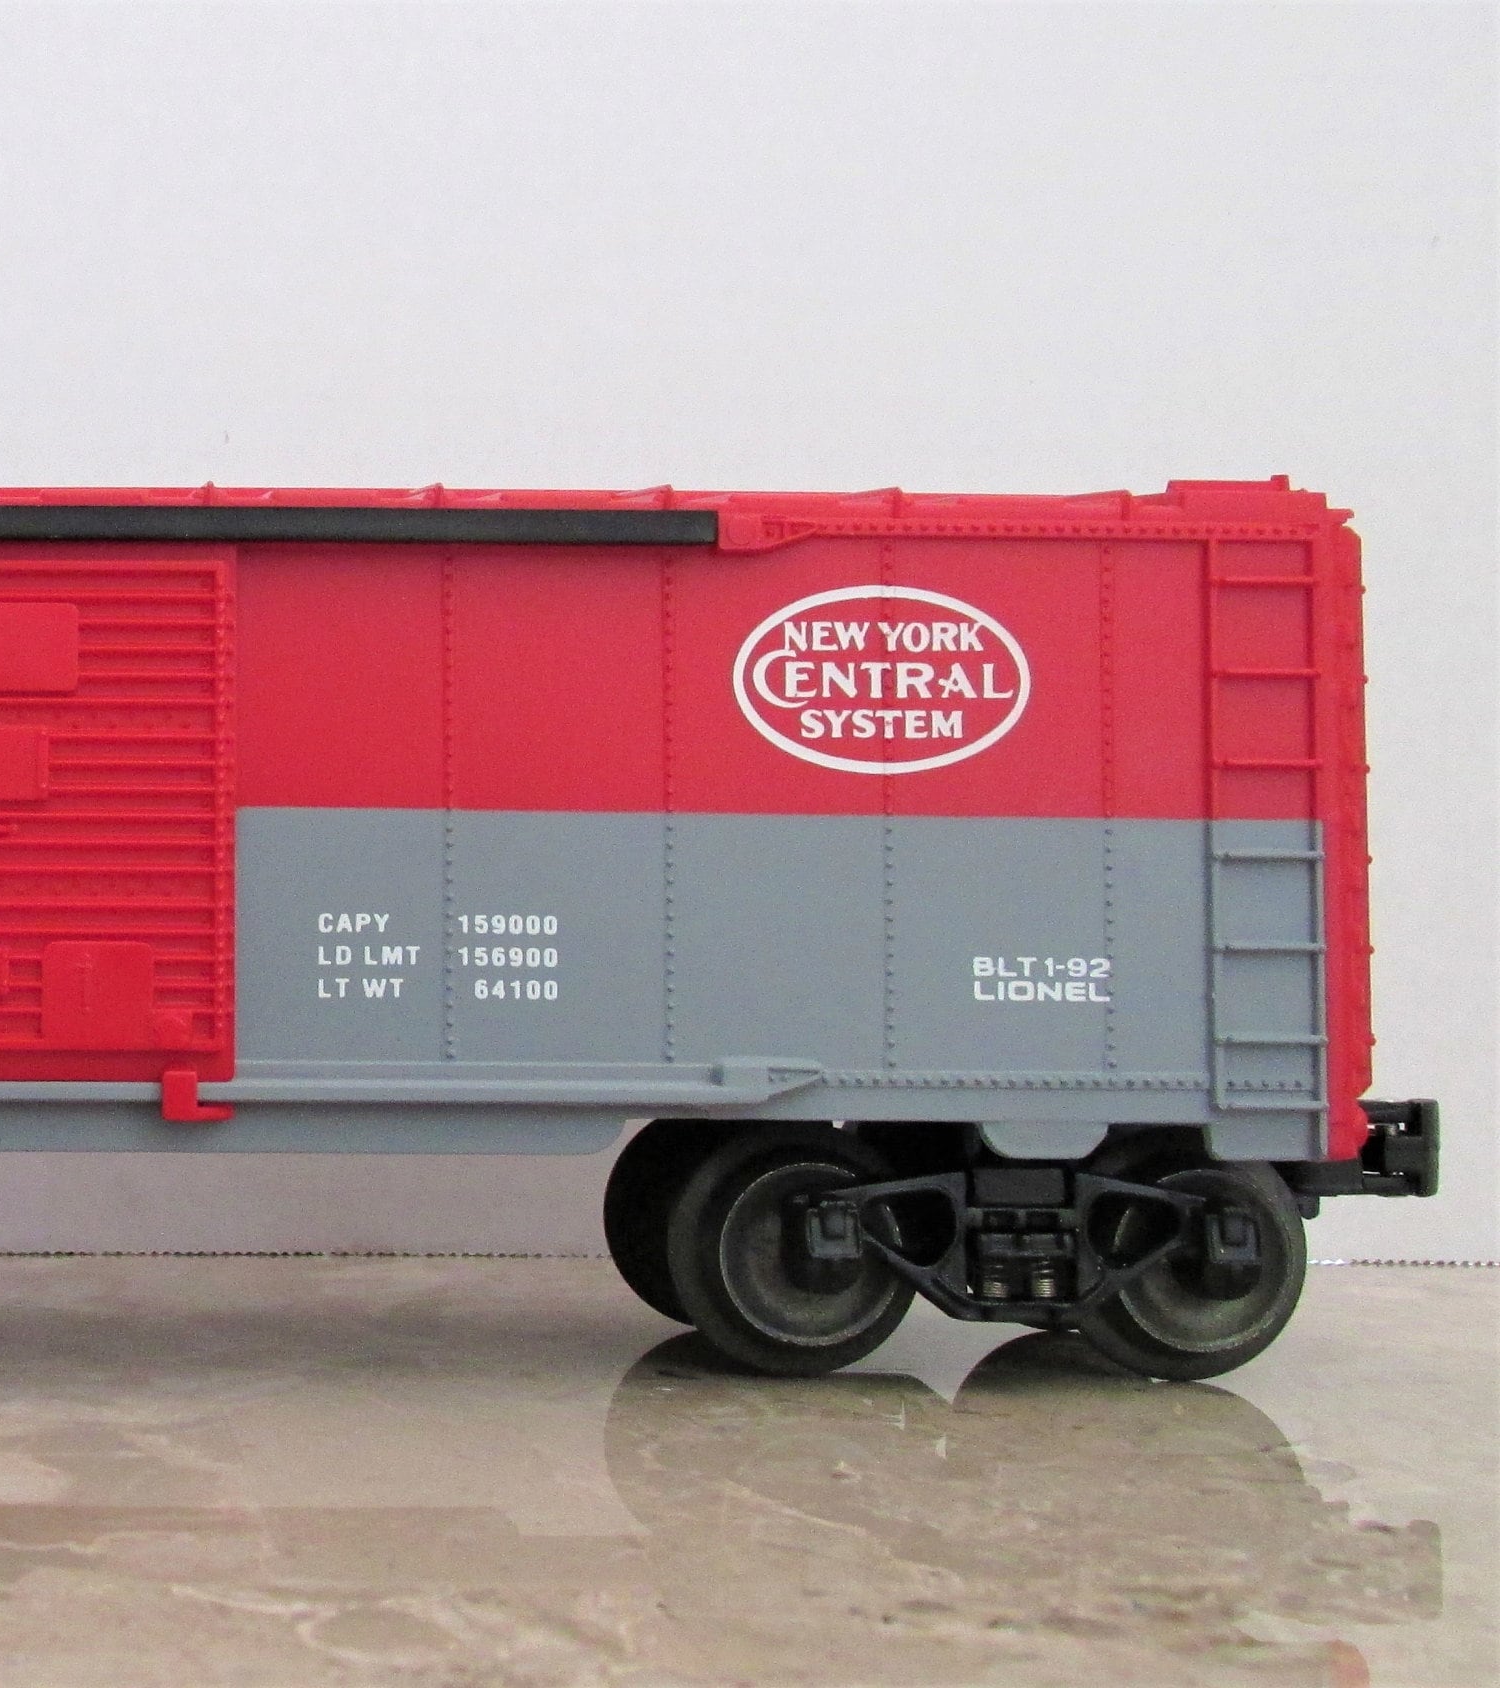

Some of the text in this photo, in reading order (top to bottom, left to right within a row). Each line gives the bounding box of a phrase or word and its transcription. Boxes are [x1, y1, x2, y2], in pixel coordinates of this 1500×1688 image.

[783, 621, 984, 653] NEW YORK
[752, 649, 1014, 708] CENTRAL
[800, 709, 964, 739] SYSTEM
[317, 913, 558, 936] CAPY 159000
[317, 945, 558, 968] LD LMT 156900
[972, 956, 1112, 978] BLT 1-92
[317, 978, 558, 1001] LT WT 64100
[973, 980, 1112, 1003] LIONEL
